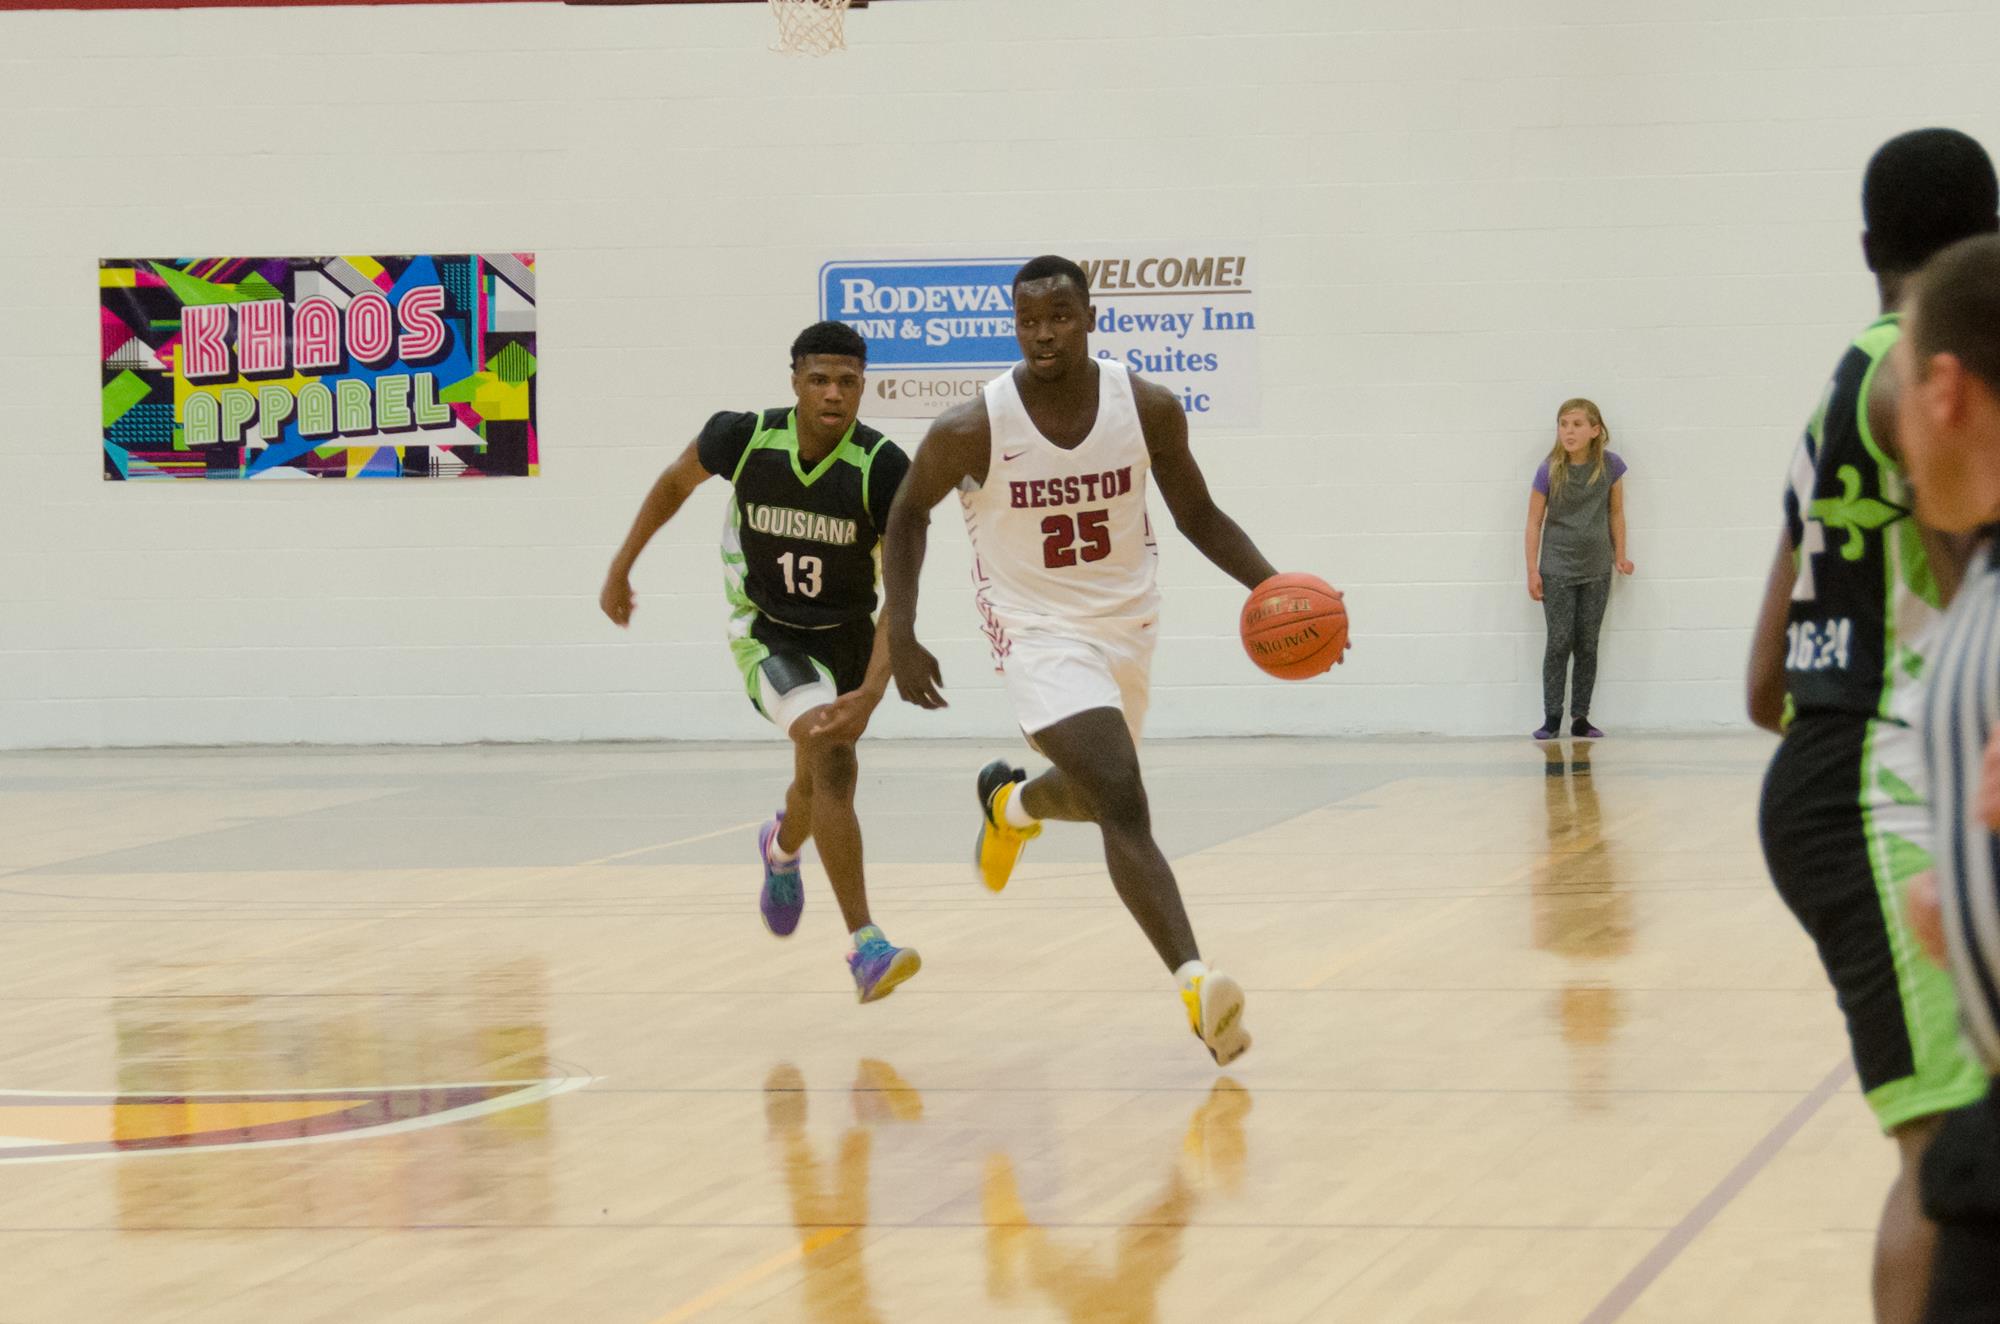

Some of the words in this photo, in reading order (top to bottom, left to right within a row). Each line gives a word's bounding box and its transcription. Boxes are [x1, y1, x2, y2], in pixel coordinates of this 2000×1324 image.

[1073, 257, 1246, 289] WELCOME!
[181, 285, 446, 377] KHAOS
[900, 318, 921, 339] &
[1097, 307, 1194, 339] deway
[1202, 307, 1256, 331] Inn
[1126, 346, 1218, 374] Suites
[183, 372, 450, 446] APPAREL
[1009, 465, 1132, 508] HESSTON
[746, 502, 857, 546] LOUISIANA
[1041, 508, 1111, 568] 25
[777, 551, 822, 598] 13
